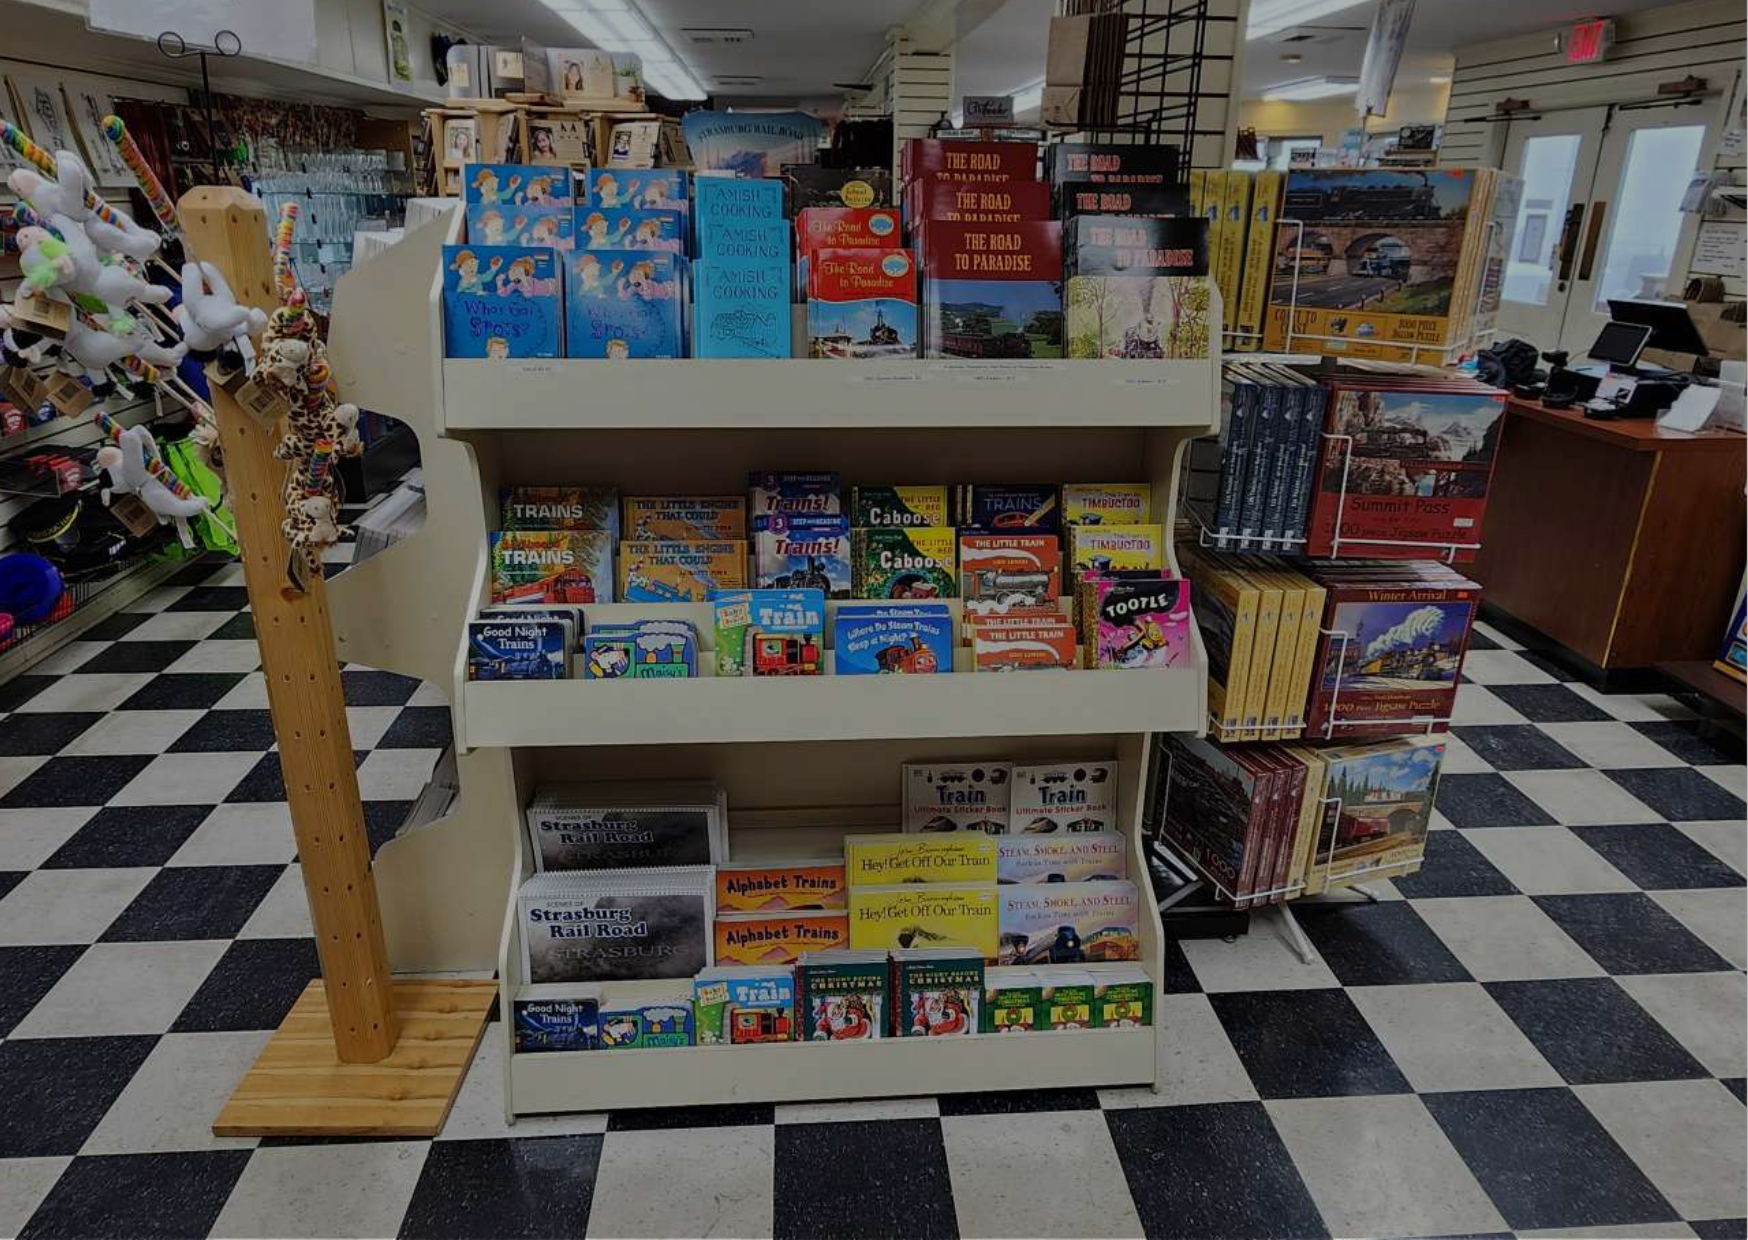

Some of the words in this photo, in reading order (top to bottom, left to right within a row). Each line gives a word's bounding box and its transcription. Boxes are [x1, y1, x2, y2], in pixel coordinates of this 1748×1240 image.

[1568, 20, 1605, 61] EXIT
[946, 152, 968, 169] THE
[970, 153, 1001, 170] ROAD
[1066, 153, 1089, 171] THE
[1089, 154, 1121, 171] ROAD
[717, 187, 760, 202] AMISH
[956, 192, 977, 209] THE
[980, 193, 1011, 210] ROAD
[1076, 192, 1098, 210] THE
[1100, 193, 1132, 211] ROAD
[711, 204, 773, 218] COOKING
[838, 220, 862, 232] Road
[722, 229, 766, 242] AMISH
[964, 233, 987, 250] THE
[990, 234, 1022, 251] ROAD
[1090, 227, 1112, 246] THE
[717, 244, 780, 258] COOKING
[823, 262, 845, 274] The
[849, 262, 874, 275] Road
[954, 254, 969, 270] TO
[973, 254, 1032, 271] PARADISE
[721, 269, 766, 283] AMISH
[852, 274, 895, 288] Paradise
[713, 286, 778, 300] COOKING
[766, 494, 830, 511] Trains!
[983, 498, 1043, 511] TRAINS
[1082, 497, 1141, 509] TIMBUCTOO
[1350, 497, 1411, 513] Summit
[1415, 498, 1452, 514] Pass
[513, 503, 583, 519] TRAINS
[656, 511, 681, 520] THAT
[685, 511, 718, 521] COULD
[869, 507, 941, 525] Caboose
[775, 518, 784, 528] 3
[628, 545, 650, 555] THE
[654, 544, 691, 554] LITTLE
[775, 538, 840, 555] Trains!
[974, 540, 992, 548] THE
[992, 539, 1018, 548] LITTLE
[1020, 539, 1045, 548] TRAIN
[1091, 539, 1150, 551] TIMBUCTOO
[501, 550, 574, 565] TRAINS
[648, 556, 676, 566] THAT
[679, 556, 713, 566] COULD
[880, 550, 952, 569] Caboose
[1367, 590, 1407, 601] Winter
[1407, 590, 1448, 601] Arrival
[1105, 592, 1170, 618] TOOTLE
[759, 608, 820, 626] Train
[985, 618, 1003, 627] THE
[1004, 618, 1028, 627] LITTLE
[1030, 617, 1056, 627] TRAIN
[483, 626, 513, 637] Good
[514, 626, 547, 640] Night
[847, 624, 874, 640] Where
[874, 622, 887, 631] Do
[888, 620, 914, 631] Steam
[913, 621, 940, 636] Trains
[989, 632, 1008, 640] THE
[1008, 631, 1036, 640] LITTLE
[1037, 630, 1064, 640] TRAIN
[497, 638, 535, 649] Trains
[846, 639, 870, 653] Sleep
[879, 632, 908, 645] Night?
[641, 665, 683, 678] Maisy's
[935, 784, 985, 803] Train
[1037, 784, 1086, 804] Train
[914, 805, 952, 814] Ultimate
[954, 805, 985, 814] Sticker
[986, 805, 1008, 813] Book
[1016, 806, 1053, 816] Ultimate
[1054, 805, 1085, 814] Sticker
[1086, 803, 1107, 812] Book
[540, 819, 638, 832] Strasburg
[559, 832, 599, 844] Rail
[602, 831, 654, 843] Road
[1071, 845, 1089, 854] AND
[1090, 843, 1118, 854] STEEL
[862, 859, 888, 873] Hey!
[888, 857, 910, 869] Get
[911, 856, 931, 868] Off
[934, 856, 957, 867] Our
[959, 854, 991, 866] Train
[1205, 847, 1235, 879] 1000
[726, 875, 788, 896] Alphabet
[793, 875, 837, 889] Trains
[1081, 897, 1101, 906] AND
[1103, 895, 1131, 906] STEEL
[530, 907, 631, 922] Strasburg
[859, 908, 886, 922] Hey!
[887, 906, 908, 918] Get
[910, 905, 932, 917] Off
[932, 905, 956, 916] Our
[957, 904, 992, 916] Train
[549, 924, 591, 938] Rail
[596, 922, 646, 937] Road
[726, 925, 789, 947] Alphabet
[794, 924, 840, 941] Trains
[810, 981, 882, 990] CHRISTMAS
[908, 975, 980, 985] CHRISTMAS
[736, 986, 791, 1001] Train
[527, 1004, 552, 1013] Good
[556, 1003, 584, 1015] Night
[539, 1014, 572, 1024] Trains
